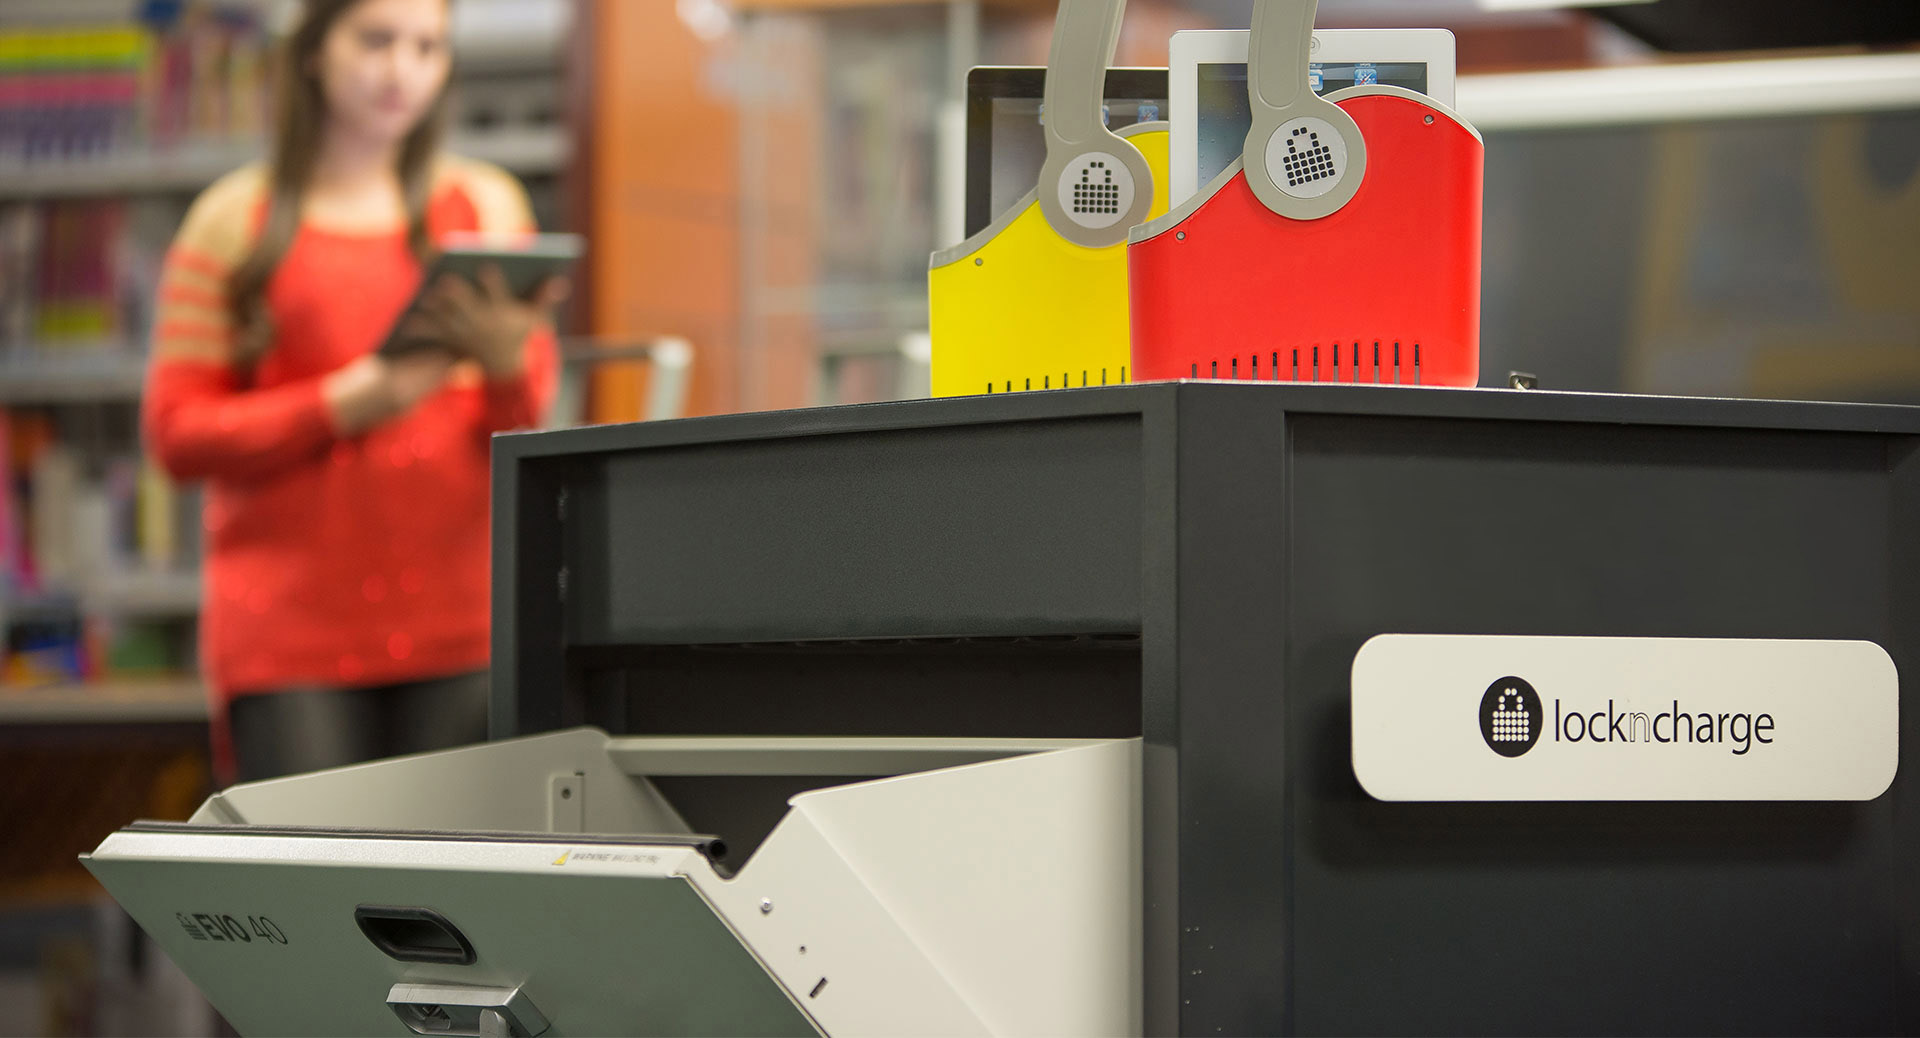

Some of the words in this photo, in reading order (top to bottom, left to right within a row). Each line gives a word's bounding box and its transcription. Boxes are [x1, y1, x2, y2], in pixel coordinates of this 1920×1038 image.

[1554, 698, 1775, 756] lockncharge
[191, 912, 251, 943] EVO
[247, 914, 289, 945] 40
